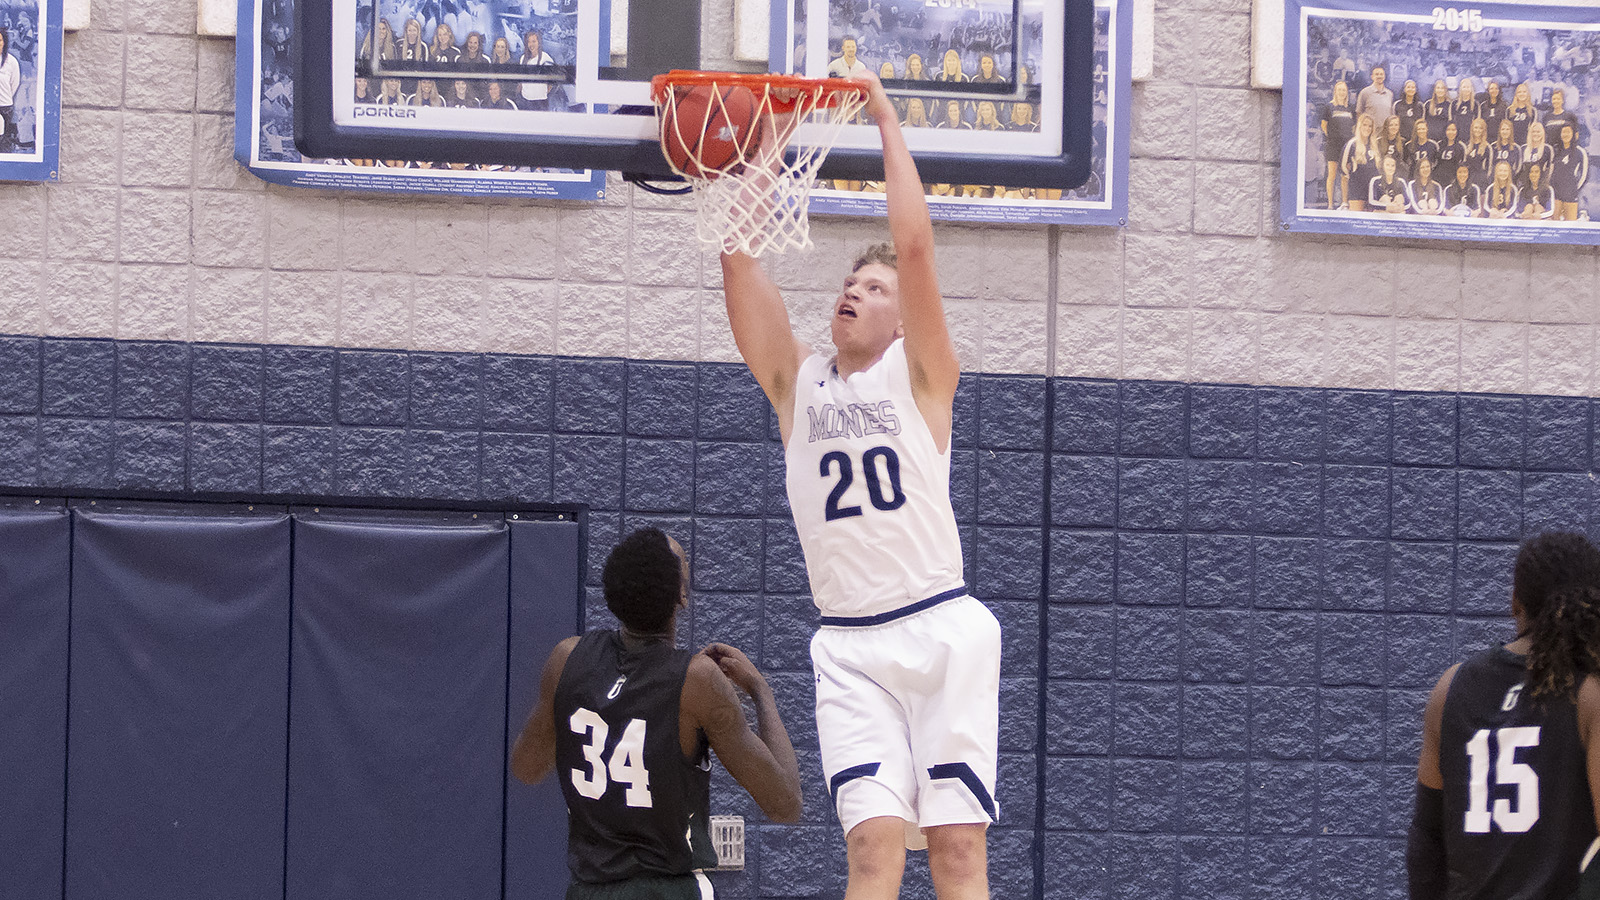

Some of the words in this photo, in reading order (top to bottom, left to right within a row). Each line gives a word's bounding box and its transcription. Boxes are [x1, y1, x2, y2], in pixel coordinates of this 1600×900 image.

[1432, 7, 1482, 32] 2015
[1407, 108, 1413, 117] 6
[1461, 106, 1467, 115] 2
[1388, 145, 1395, 154] 5
[1497, 150, 1509, 160] 10
[1562, 155, 1569, 164] 4
[807, 400, 902, 443] MINES
[819, 446, 907, 522] 20
[569, 707, 653, 808] 34
[1464, 726, 1541, 833] 15
